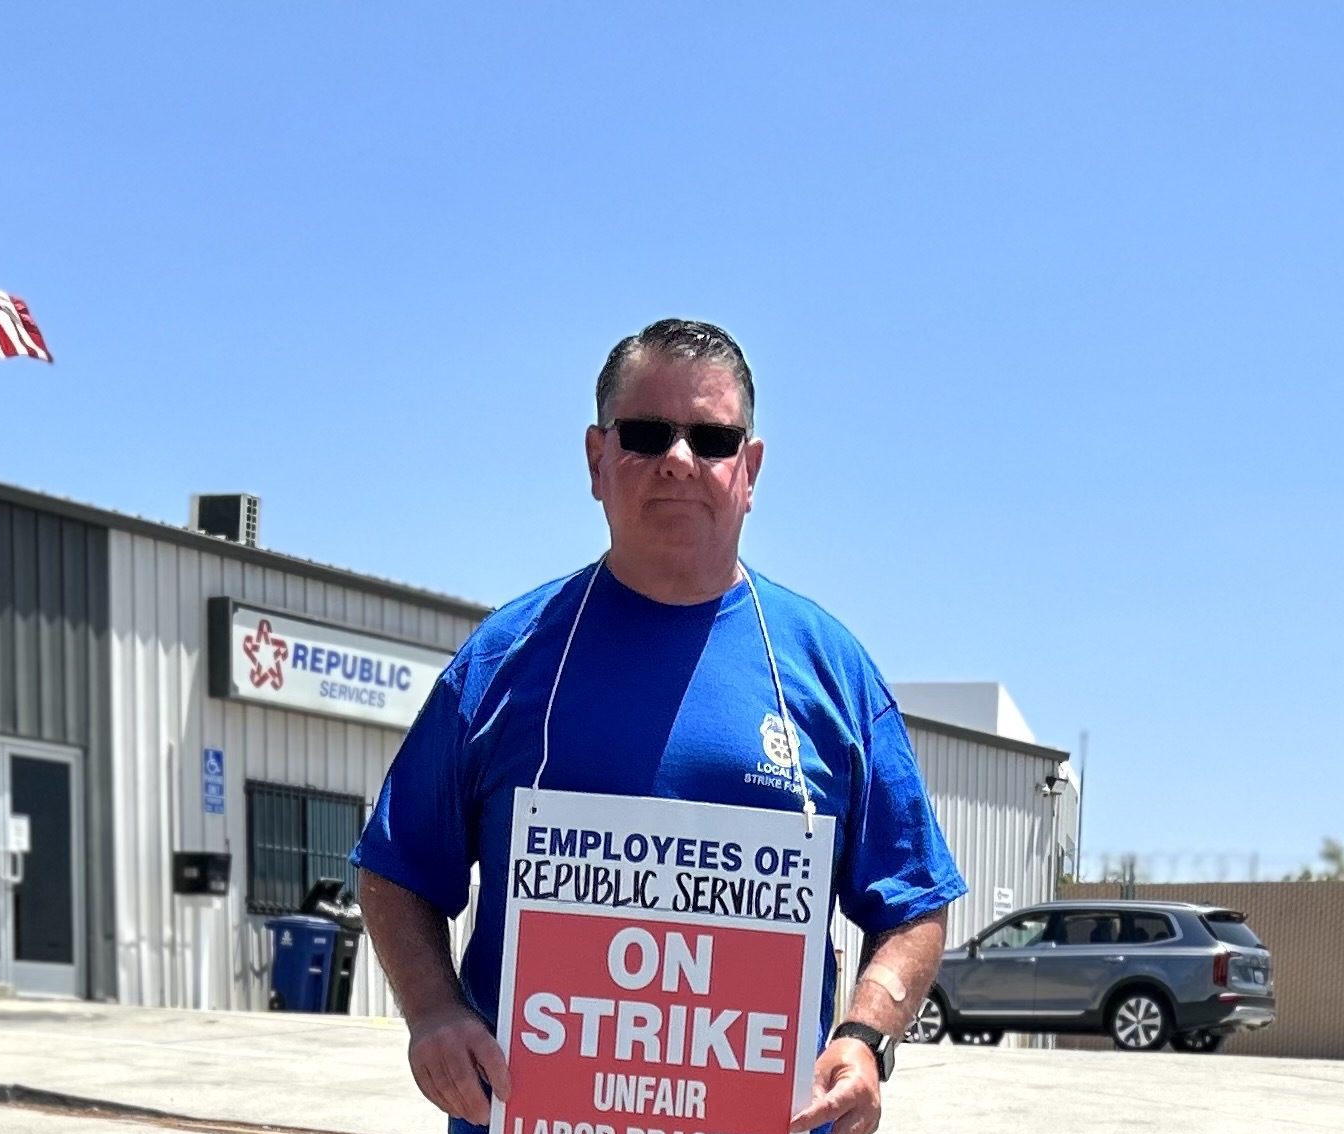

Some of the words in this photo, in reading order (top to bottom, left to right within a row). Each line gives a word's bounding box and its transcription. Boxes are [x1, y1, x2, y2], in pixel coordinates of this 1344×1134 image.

[292, 643, 412, 691] REPUBLIC
[320, 680, 386, 708] SERVICES
[744, 773, 783, 790] STRIKE
[757, 761, 792, 780] LOCAL
[526, 826, 742, 872] EMPLOYEES
[755, 846, 811, 879] OF:
[513, 859, 657, 909] REPUBLIC
[672, 873, 813, 923] SERVICES
[607, 927, 714, 995] ON
[521, 992, 788, 1074] STRIKE
[593, 1072, 707, 1119] UNFAIR
